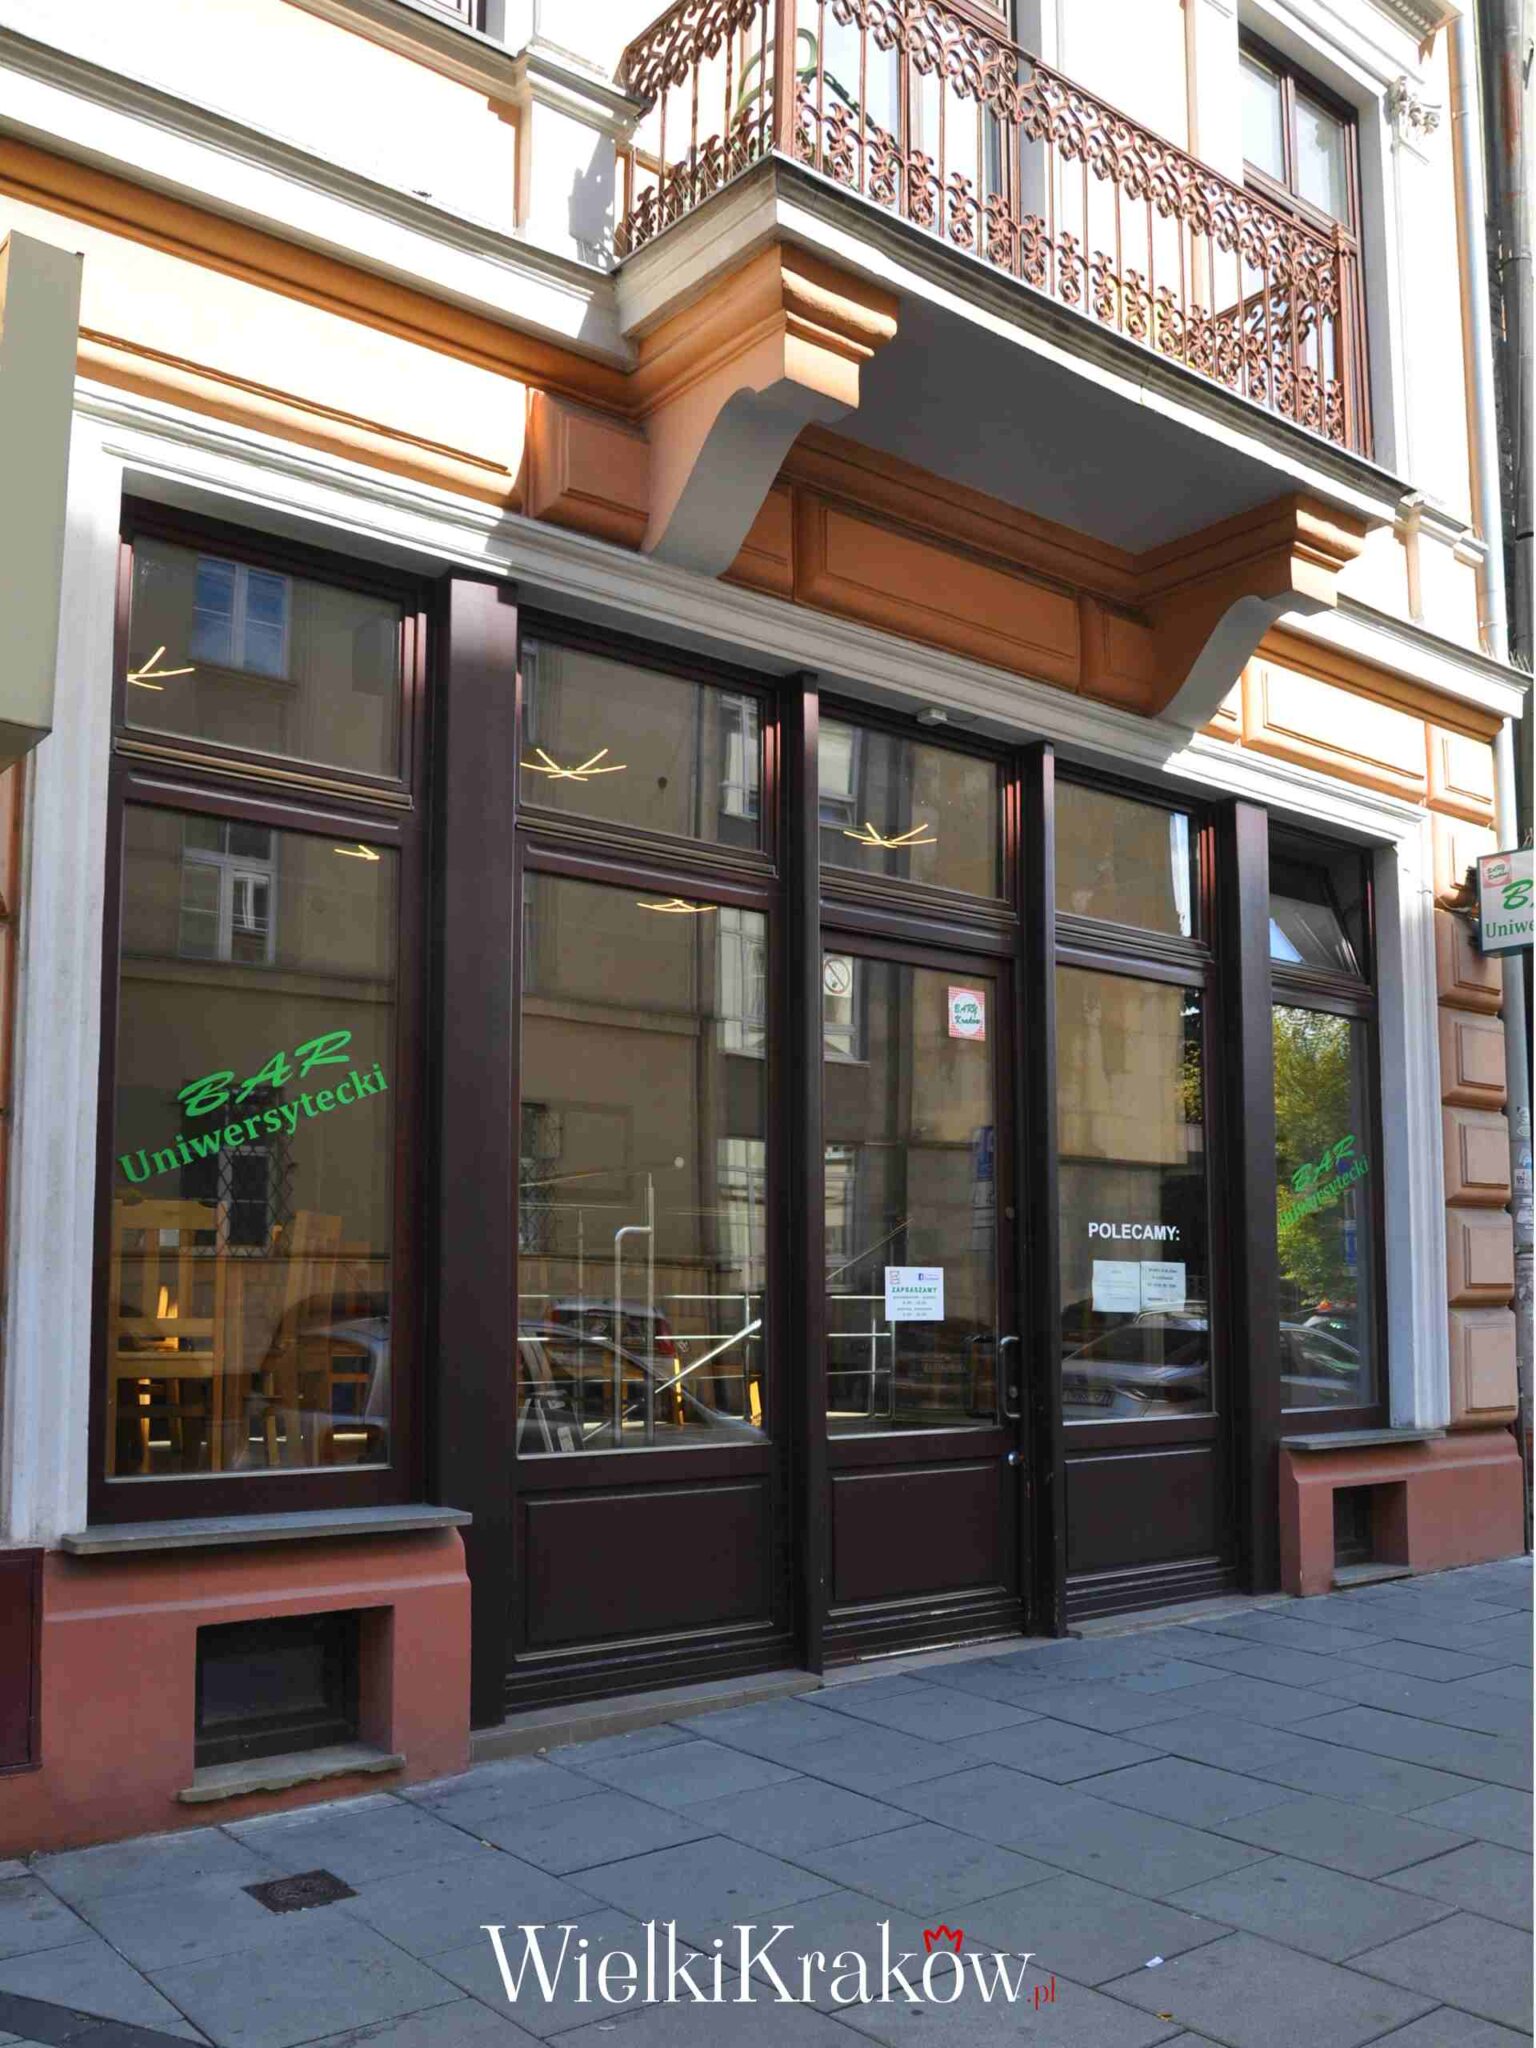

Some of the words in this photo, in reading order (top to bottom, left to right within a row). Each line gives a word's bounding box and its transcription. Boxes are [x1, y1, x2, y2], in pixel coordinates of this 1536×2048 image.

[177, 1030, 352, 1117] BAR
[118, 1062, 389, 1184] Uniwersytecki
[1291, 1134, 1356, 1193] BAR
[1088, 1222, 1180, 1241] POLECAMY:
